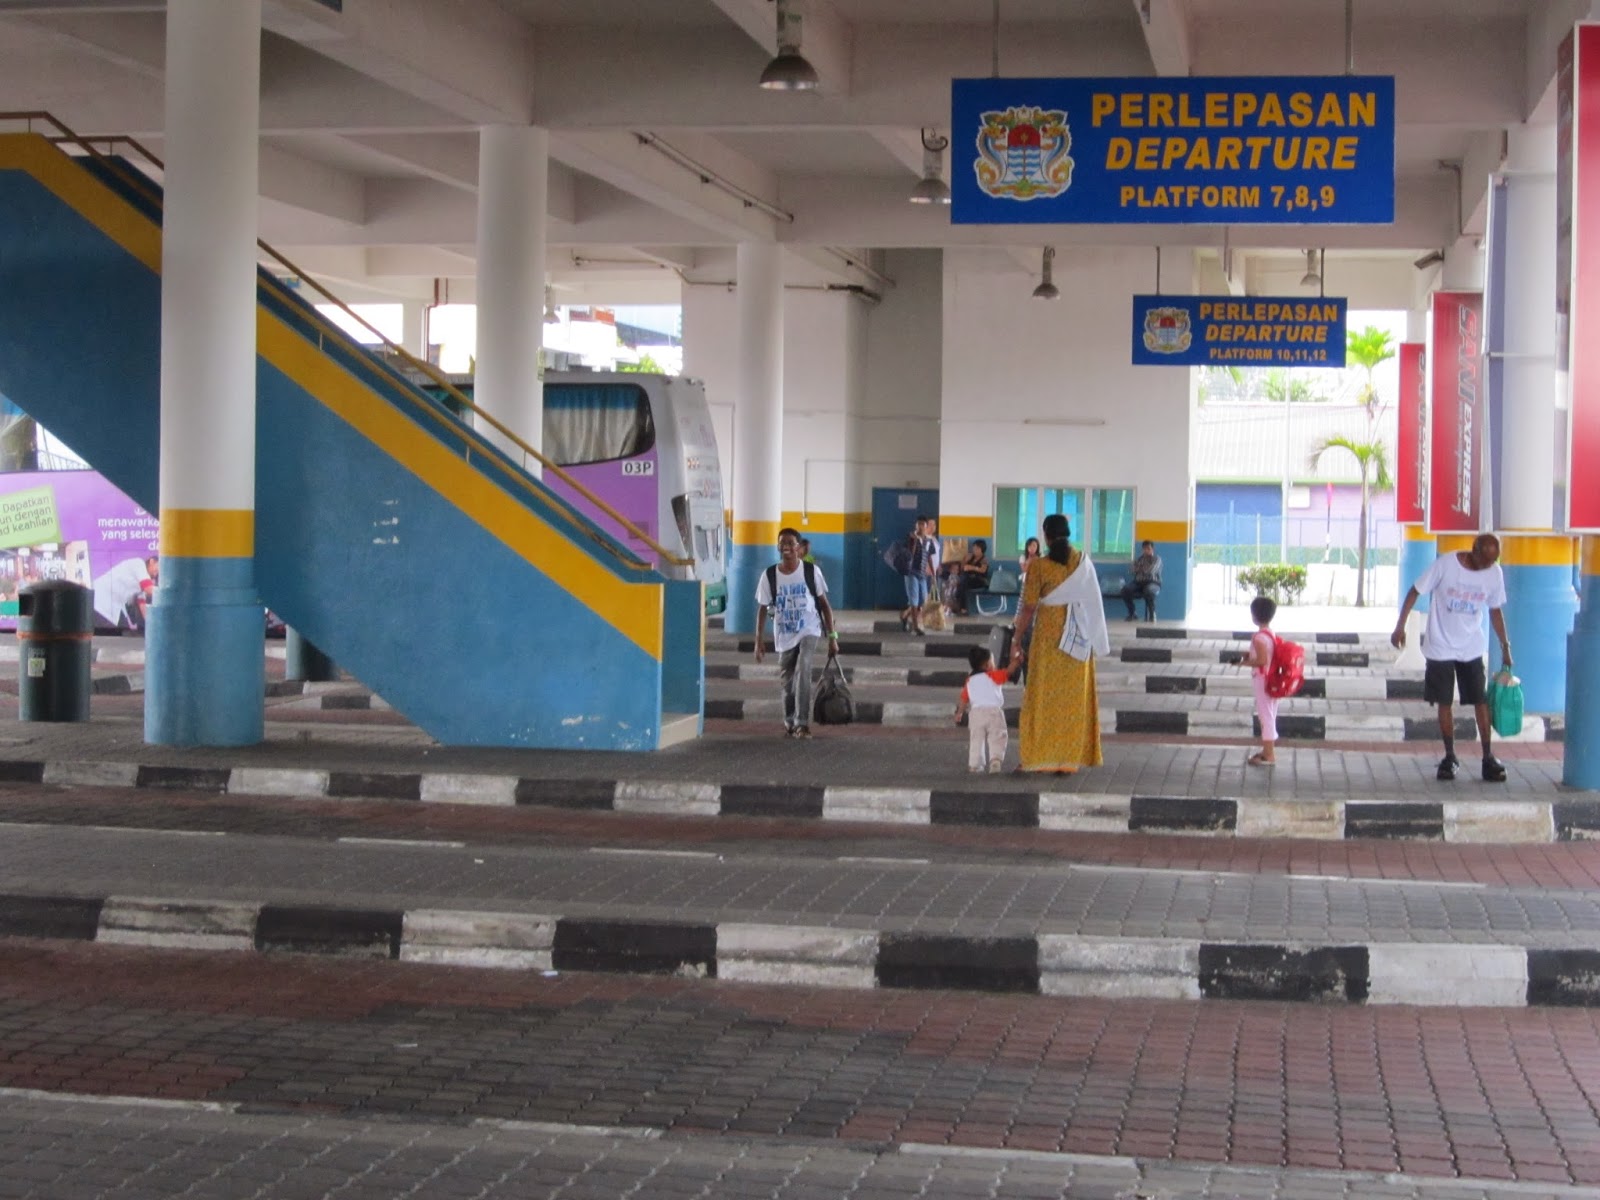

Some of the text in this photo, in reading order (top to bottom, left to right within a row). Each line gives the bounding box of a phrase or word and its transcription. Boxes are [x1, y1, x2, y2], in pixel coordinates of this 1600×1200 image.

[1091, 92, 1376, 128] PERLEPASAN
[1105, 136, 1359, 170] DEPARTURE
[1120, 185, 1335, 210] PLATFORM 7,8,9
[1199, 302, 1338, 322] PERLEPASAN
[1205, 324, 1328, 343] DEPARTURE
[1210, 348, 1327, 362] PLATFORM 10,11,12
[624, 462, 651, 474] 03P
[1462, 402, 1472, 517] EXPRESS
[3, 496, 50, 513] Dapatkan
[14, 506, 52, 521] dengan
[101, 530, 128, 542] yang
